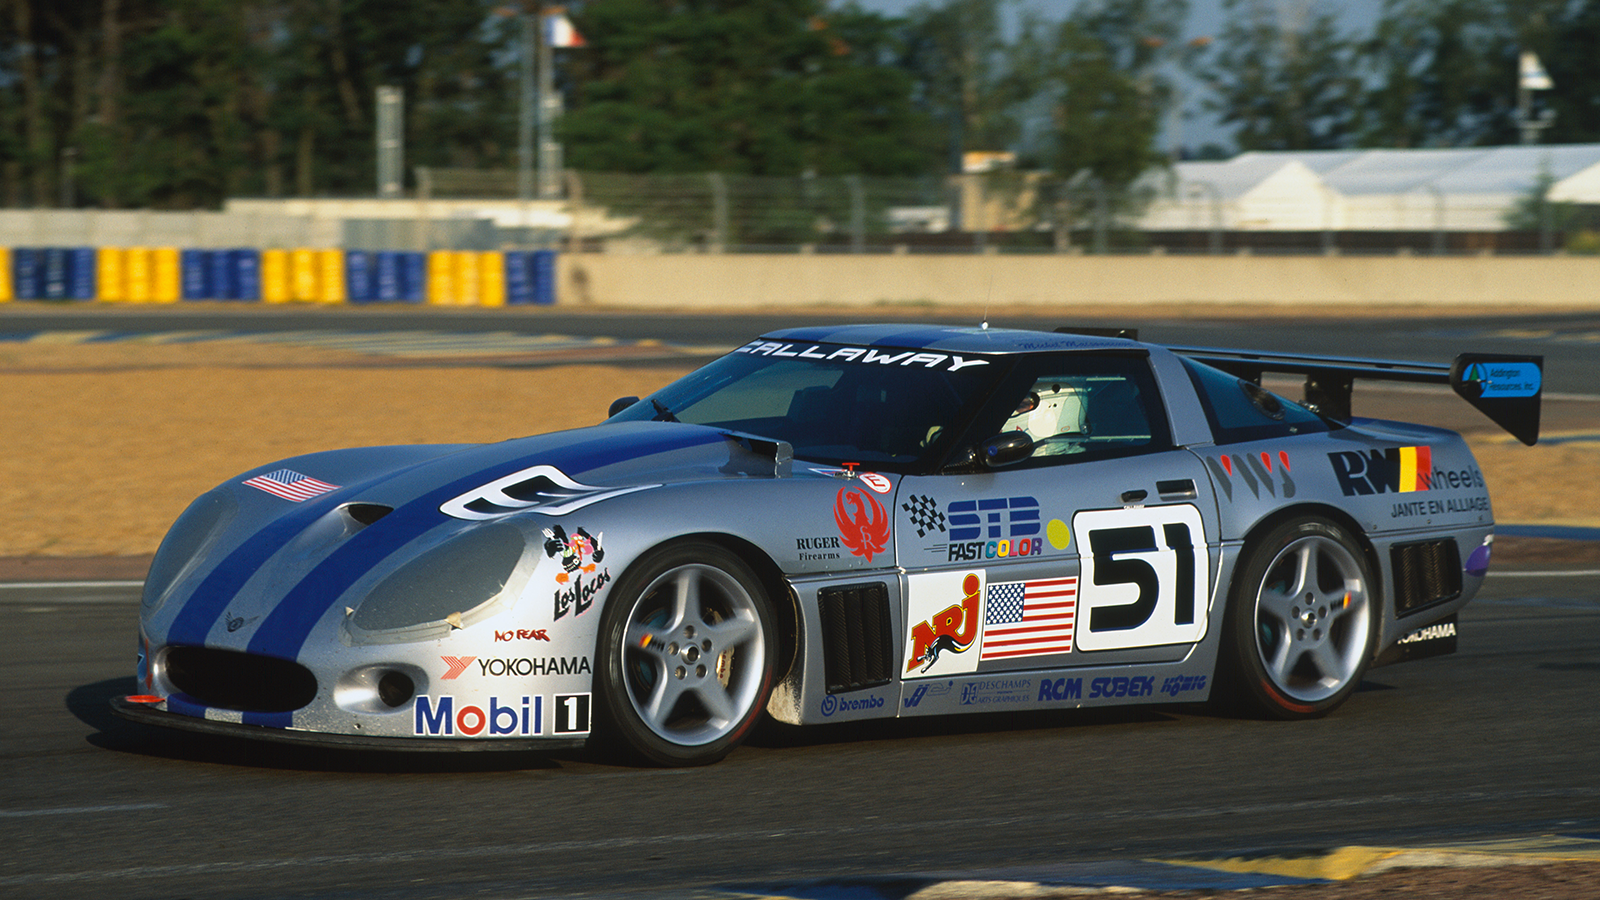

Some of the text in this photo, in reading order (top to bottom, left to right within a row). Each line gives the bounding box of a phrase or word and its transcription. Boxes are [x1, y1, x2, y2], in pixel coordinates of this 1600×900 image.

[735, 340, 990, 373] CALLAWAY
[1417, 464, 1484, 491] wheels
[1391, 497, 1489, 518] JANTE EN ALLIAGE
[796, 537, 841, 550] RUGER
[799, 552, 841, 561] Firearms
[1089, 522, 1195, 633] 51
[553, 567, 611, 622] Los Locos
[494, 628, 551, 643] NO FEAR
[478, 656, 592, 677] YOKOHAMA
[979, 679, 1031, 691] DESCHAMPS
[1038, 678, 1083, 701] RCM
[839, 694, 885, 711] brembo
[415, 695, 578, 736] Mobil 1
